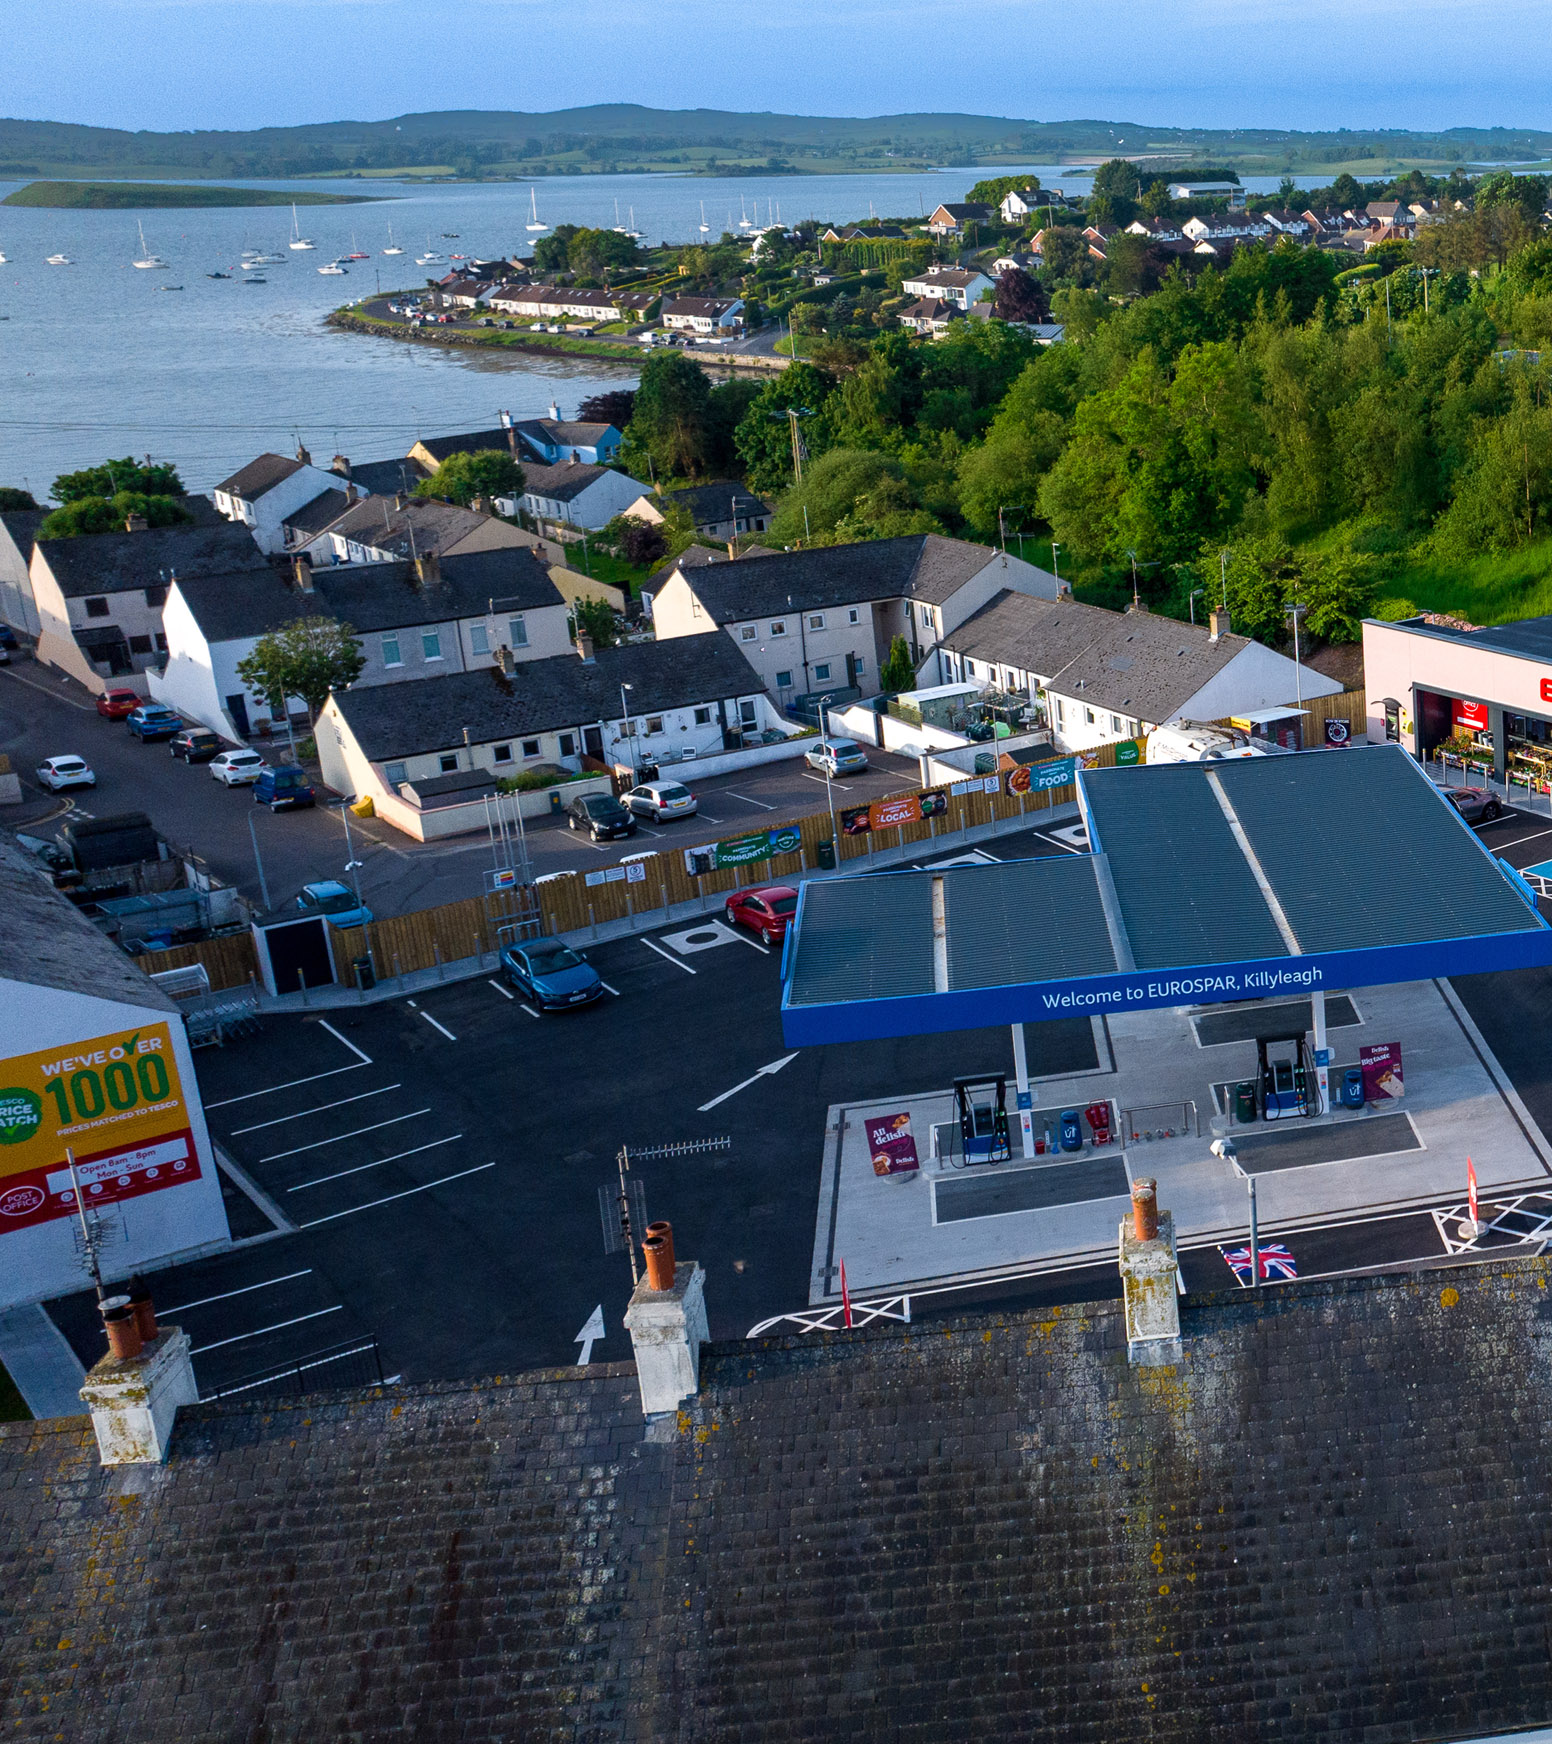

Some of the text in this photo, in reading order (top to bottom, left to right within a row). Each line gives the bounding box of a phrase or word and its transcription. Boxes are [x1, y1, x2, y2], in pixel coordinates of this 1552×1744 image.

[1038, 772, 1069, 787] FOOD
[880, 811, 912, 823] LOCAL
[721, 846, 767, 862] COMMUNITY
[1042, 966, 1323, 1009] Welcome to EUROSPAR, Killyleagh
[41, 1033, 163, 1077] WE'VE OVER
[45, 1053, 170, 1125] 1000
[0, 1104, 33, 1117] RICE
[56, 1123, 91, 1136] PRICES
[90, 1112, 133, 1127] MATCHED
[136, 1107, 148, 1116] TO
[149, 1100, 179, 1112] TESCO
[0, 1114, 38, 1127] ATCH
[875, 1129, 906, 1145] delish
[80, 1163, 106, 1176] Open
[109, 1157, 128, 1167] 8am
[136, 1149, 156, 1160] 8pm
[97, 1169, 118, 1179] Mon
[126, 1162, 144, 1172] Sun
[3, 1196, 39, 1212] OFFICE
[7, 1190, 33, 1203] POST
